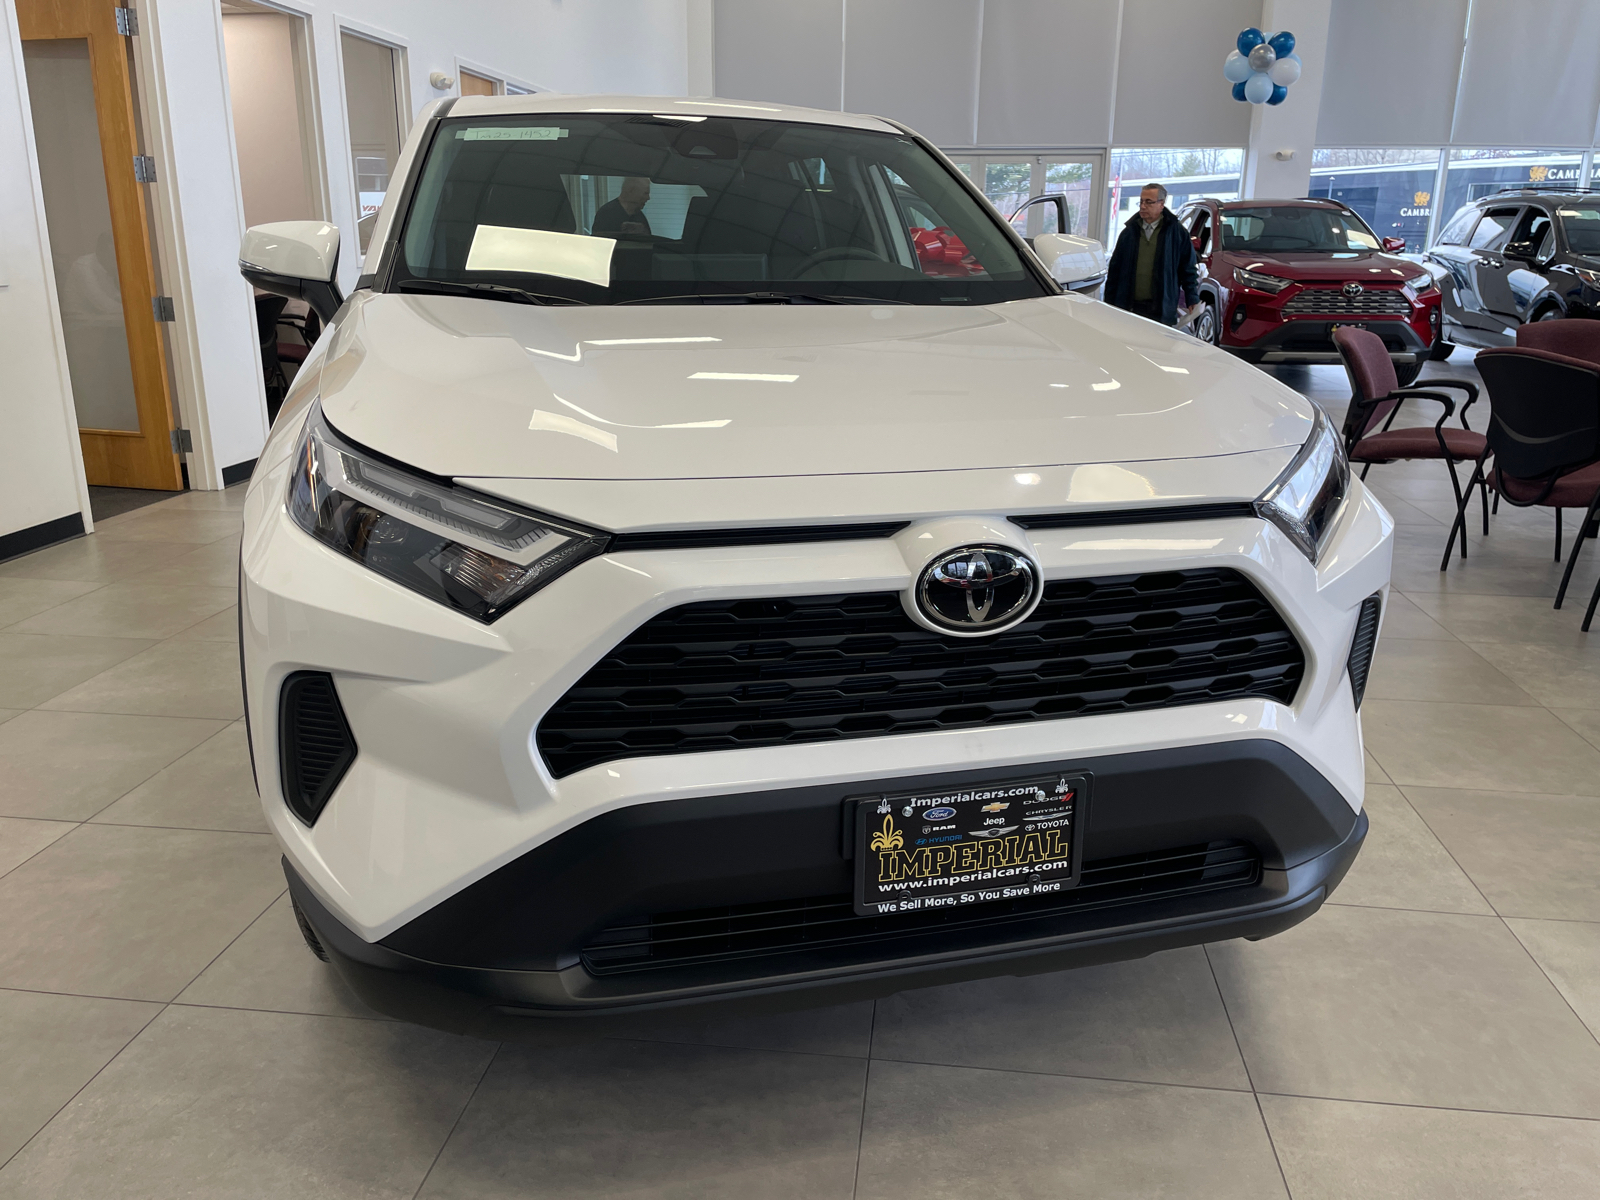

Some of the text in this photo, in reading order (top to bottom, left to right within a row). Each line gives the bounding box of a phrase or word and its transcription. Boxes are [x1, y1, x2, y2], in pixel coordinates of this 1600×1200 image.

[910, 785, 1038, 808] Imperialcars.com
[1025, 806, 1072, 816] CHRYSLER
[983, 817, 1005, 826] Jeep
[1036, 819, 1069, 830] TOYOTA
[928, 834, 962, 844] HYUNDAI
[878, 829, 1068, 882] IMPERIAL
[878, 860, 1068, 892] www.imperialcars.com
[878, 882, 1060, 913] We Sell More, So You Save More
